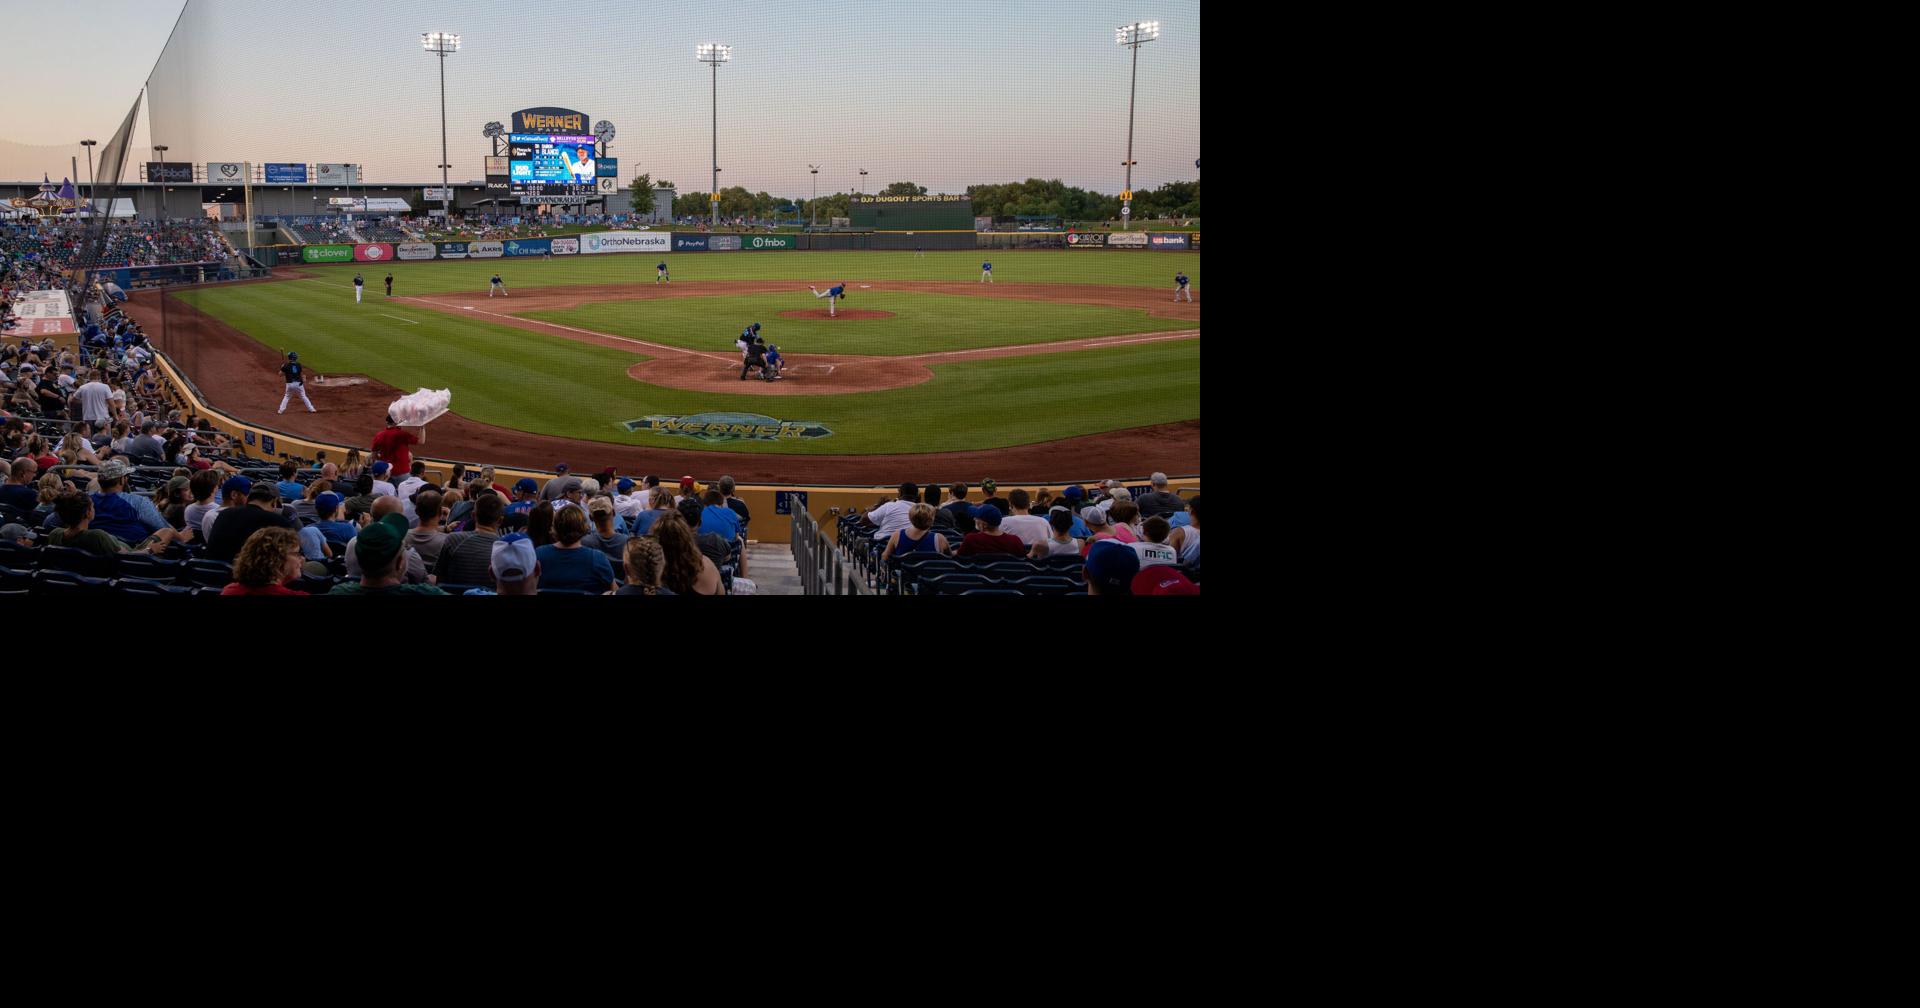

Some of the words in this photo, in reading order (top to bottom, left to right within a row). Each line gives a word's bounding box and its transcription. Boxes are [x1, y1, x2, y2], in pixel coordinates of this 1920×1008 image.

[522, 112, 582, 130] WERNER
[601, 237, 665, 247] OrthoNebraska
[765, 238, 786, 247] fnbo
[319, 249, 348, 258] clover
[651, 417, 806, 438] WERNER
